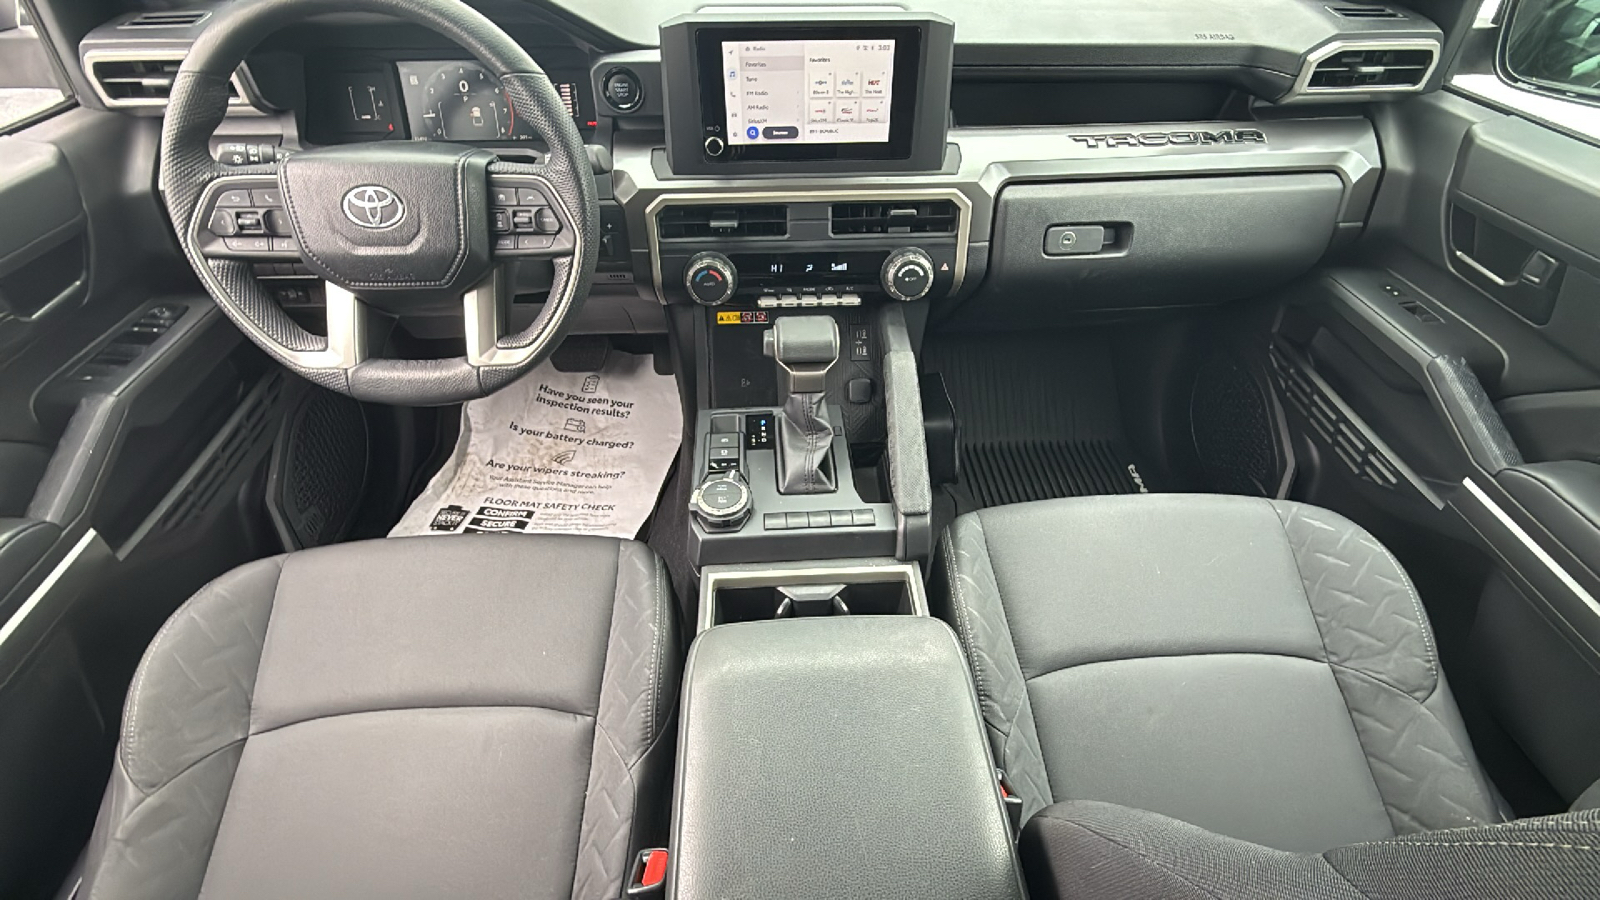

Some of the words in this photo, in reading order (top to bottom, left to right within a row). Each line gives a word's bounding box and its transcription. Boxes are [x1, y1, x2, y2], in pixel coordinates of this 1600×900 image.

[459, 80, 469, 93] 0
[1067, 127, 1269, 149] TACOMA
[538, 383, 565, 398] Have
[565, 393, 586, 403] you
[586, 397, 609, 405] seen
[610, 399, 634, 409] your
[536, 393, 590, 414] inspection
[591, 407, 631, 419] results?
[509, 421, 518, 431] Is
[518, 427, 545, 438] your
[545, 431, 586, 446] battery
[586, 438, 635, 449] charged?
[485, 459, 505, 469] Are
[506, 464, 533, 473] your
[533, 466, 568, 477] wipers
[570, 471, 626, 480] streaking?
[556, 481, 585, 489] Manager
[483, 496, 519, 507] FLOOR
[519, 501, 543, 509] MAT
[542, 502, 580, 511] SAFETY
[581, 503, 617, 511] CHECK
[436, 514, 464, 522] NEVER
[483, 508, 528, 518] CONFIRM
[480, 519, 517, 528] SECURE
